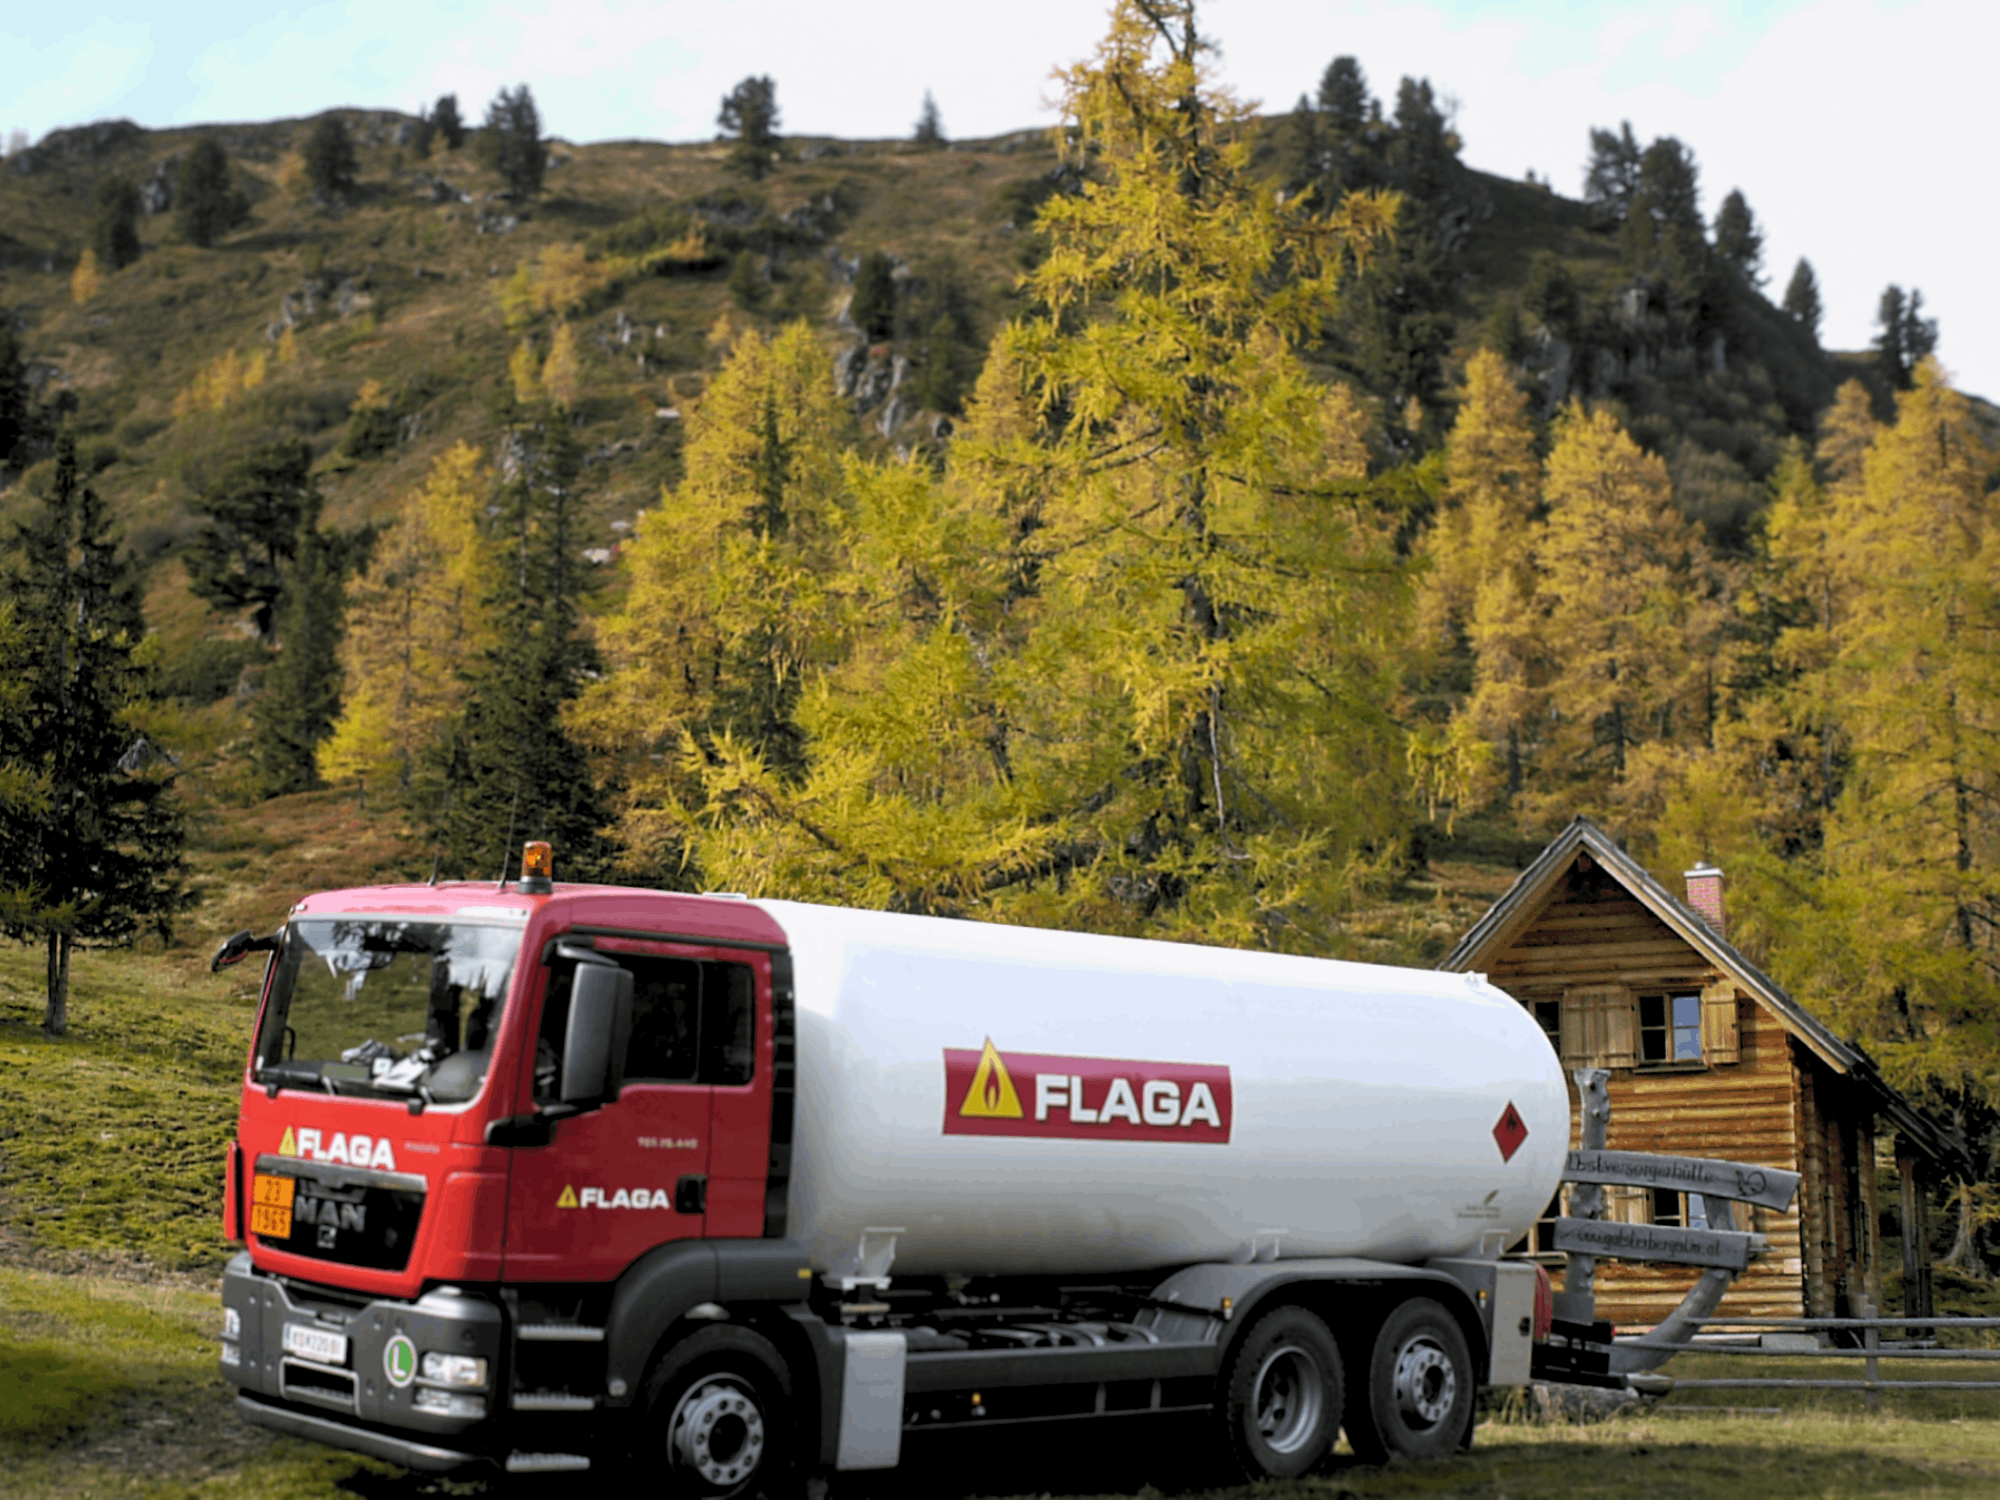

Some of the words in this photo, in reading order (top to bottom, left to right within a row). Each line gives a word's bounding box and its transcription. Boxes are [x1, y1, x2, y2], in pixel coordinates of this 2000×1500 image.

[1035, 1073, 1221, 1127] FLAGA
[298, 1127, 396, 1170] FLAGA
[294, 1195, 367, 1233] MAN
[580, 1187, 670, 1210] FLAGA
